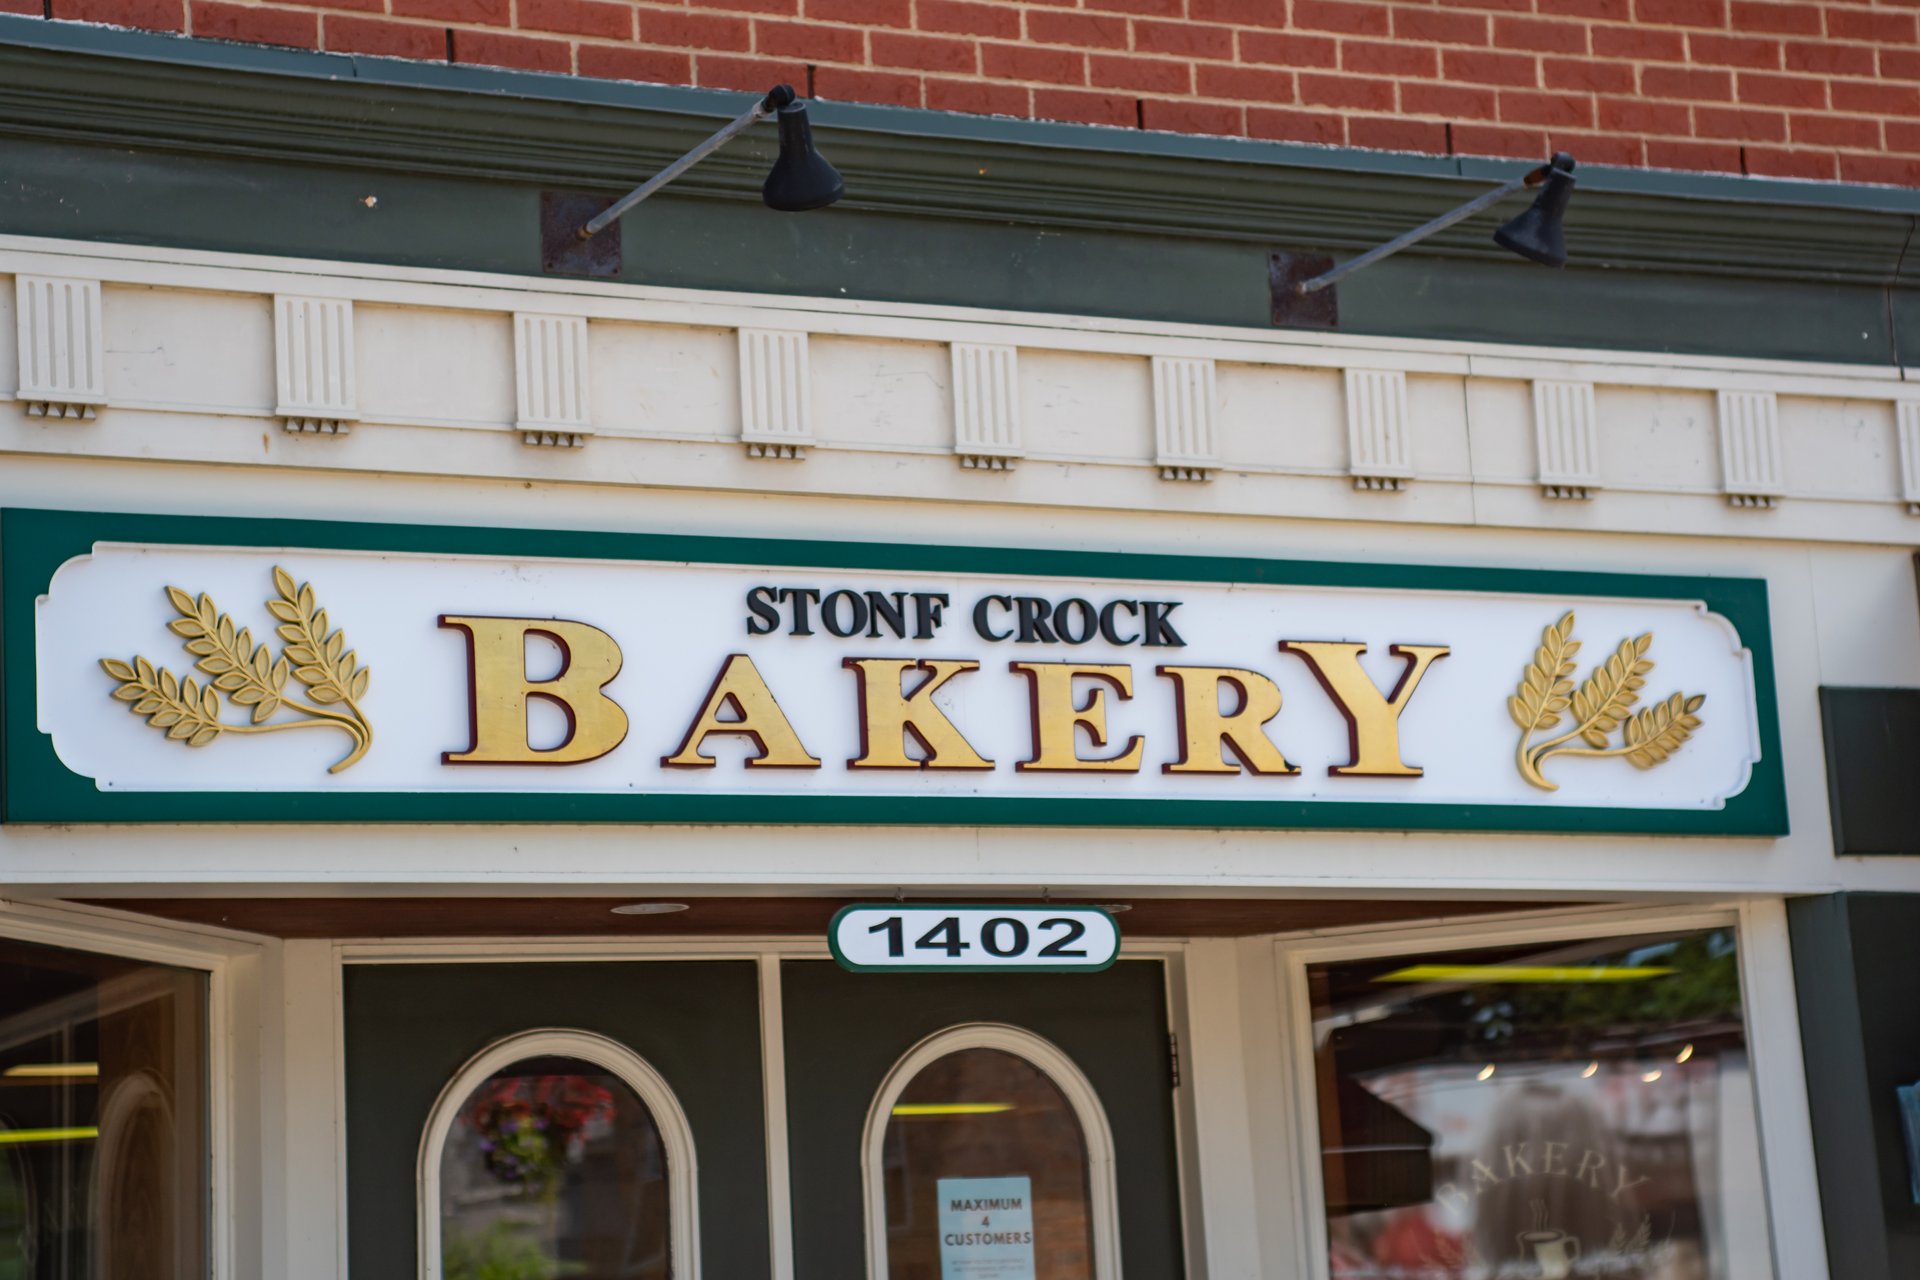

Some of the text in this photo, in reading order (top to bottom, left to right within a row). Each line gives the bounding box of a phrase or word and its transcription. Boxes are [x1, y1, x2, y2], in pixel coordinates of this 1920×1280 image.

[973, 594, 1187, 647] CROCK
[438, 614, 1450, 777] BAKERY
[868, 916, 1088, 958] 1402
[951, 1198, 1022, 1211] MAXIMUM
[981, 1215, 990, 1228] 4
[945, 1231, 1032, 1246] CUSTOMERS
